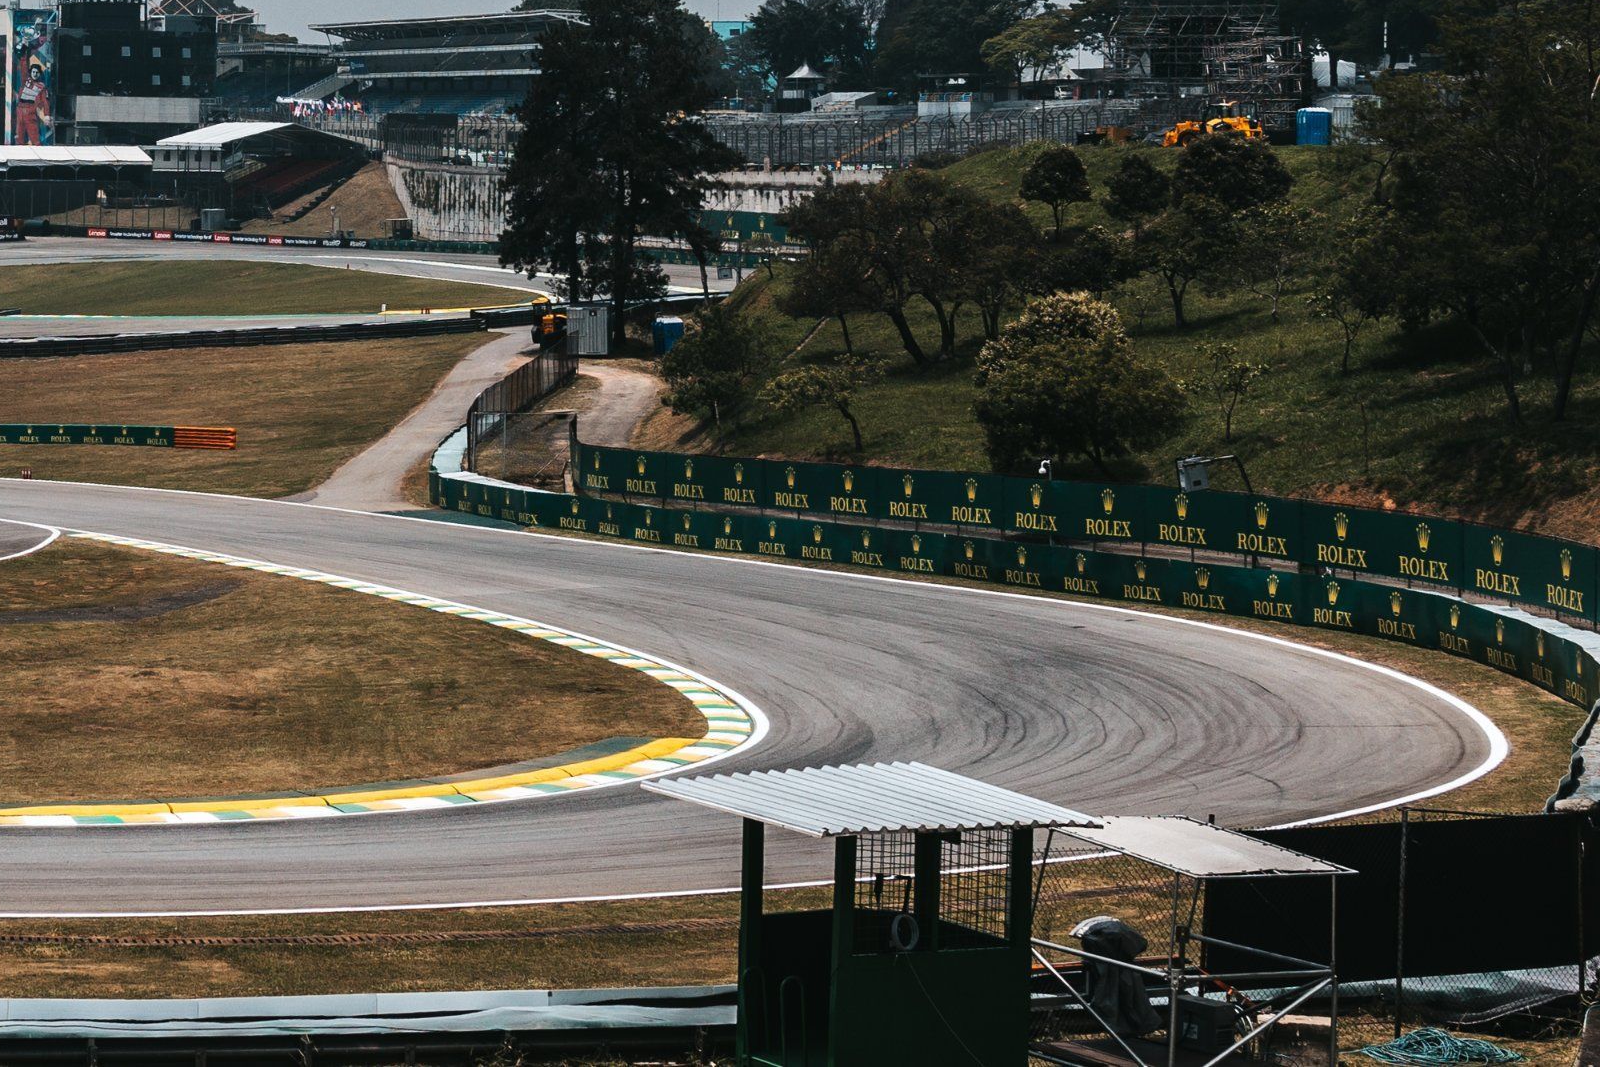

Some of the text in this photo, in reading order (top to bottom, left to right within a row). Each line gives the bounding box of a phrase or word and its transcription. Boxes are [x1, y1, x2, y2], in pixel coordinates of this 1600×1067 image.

[0, 218, 8, 226] all
[147, 437, 167, 445] ROLEX
[586, 474, 609, 489] ROLEX
[626, 478, 656, 494] ROLEX
[674, 483, 704, 499] ROLEX
[724, 487, 755, 503] ROLEX
[775, 492, 809, 508] ROLEX
[831, 496, 867, 514] ROLEX
[889, 501, 927, 519] ROLEX
[952, 506, 991, 524] ROLEX
[560, 517, 586, 529] ROLEX
[599, 522, 620, 535] ROLEX
[1016, 512, 1057, 532] ROLEX
[1085, 518, 1131, 537] ROLEX
[635, 528, 660, 541] ROLEX
[675, 533, 698, 546] ROLEX
[1159, 524, 1206, 545] ROLEX
[715, 537, 741, 551] ROLEX
[759, 541, 786, 555] ROLEX
[1237, 532, 1287, 555] ROLEX
[802, 546, 832, 560] ROLEX
[852, 551, 883, 566] ROLEX
[1317, 543, 1367, 568] ROLEX
[901, 556, 934, 571] ROLEX
[955, 562, 988, 579] ROLEX
[1399, 555, 1449, 581] ROLEX
[1006, 569, 1041, 585] ROLEX
[1064, 577, 1099, 593] ROLEX
[1476, 568, 1520, 595] ROLEX
[1124, 584, 1162, 601] ROLEX
[1183, 591, 1226, 610] ROLEX
[1547, 584, 1583, 612] ROLEX
[1253, 600, 1293, 618] ROLEX
[1314, 608, 1352, 627] ROLEX
[1378, 618, 1416, 640] ROLEX
